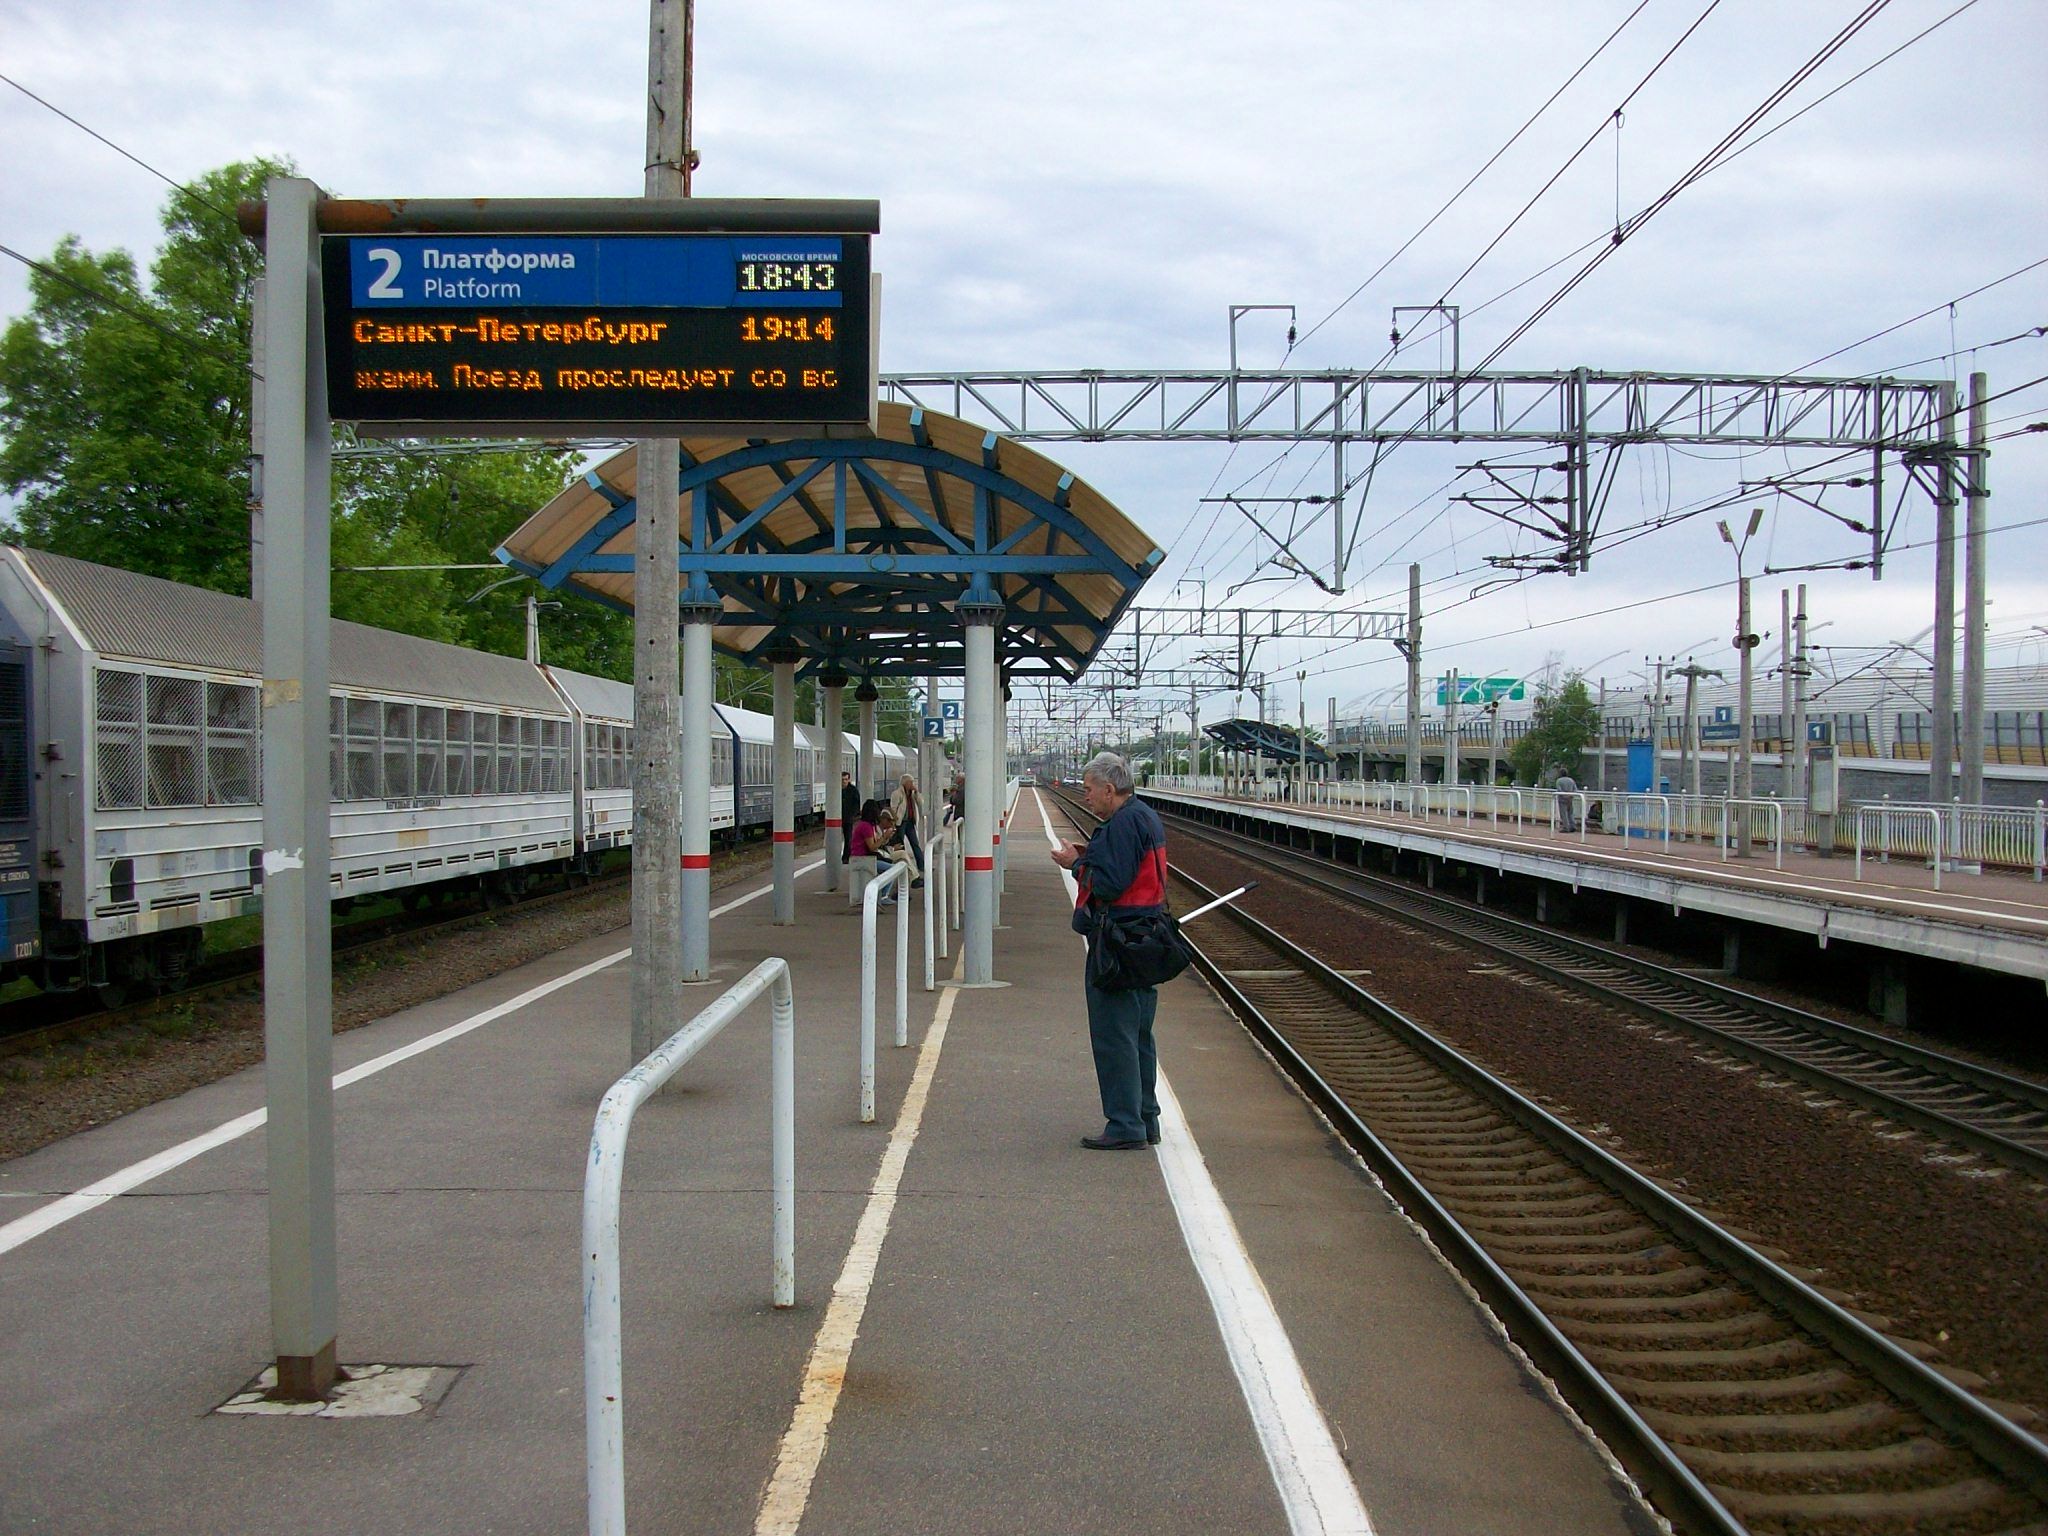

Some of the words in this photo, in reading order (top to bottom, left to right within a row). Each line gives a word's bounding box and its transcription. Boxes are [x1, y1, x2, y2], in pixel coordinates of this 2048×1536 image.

[741, 253, 805, 261] МОСКОВСКОЕ
[806, 253, 838, 261] ВРЕМЯ
[368, 248, 404, 299] 2
[423, 248, 576, 274] Платформа
[741, 263, 835, 290] 18:43
[424, 277, 521, 299] Platform
[353, 316, 668, 345] Санкт-Петербург
[741, 317, 835, 341] 19:14
[452, 364, 543, 390] Поезд
[557, 369, 735, 391] проследует
[750, 369, 787, 388] со
[802, 369, 838, 388] вс
[946, 705, 955, 717] 2
[1719, 709, 1726, 721] 1
[929, 721, 939, 735] 2
[1812, 726, 1821, 739] 1
